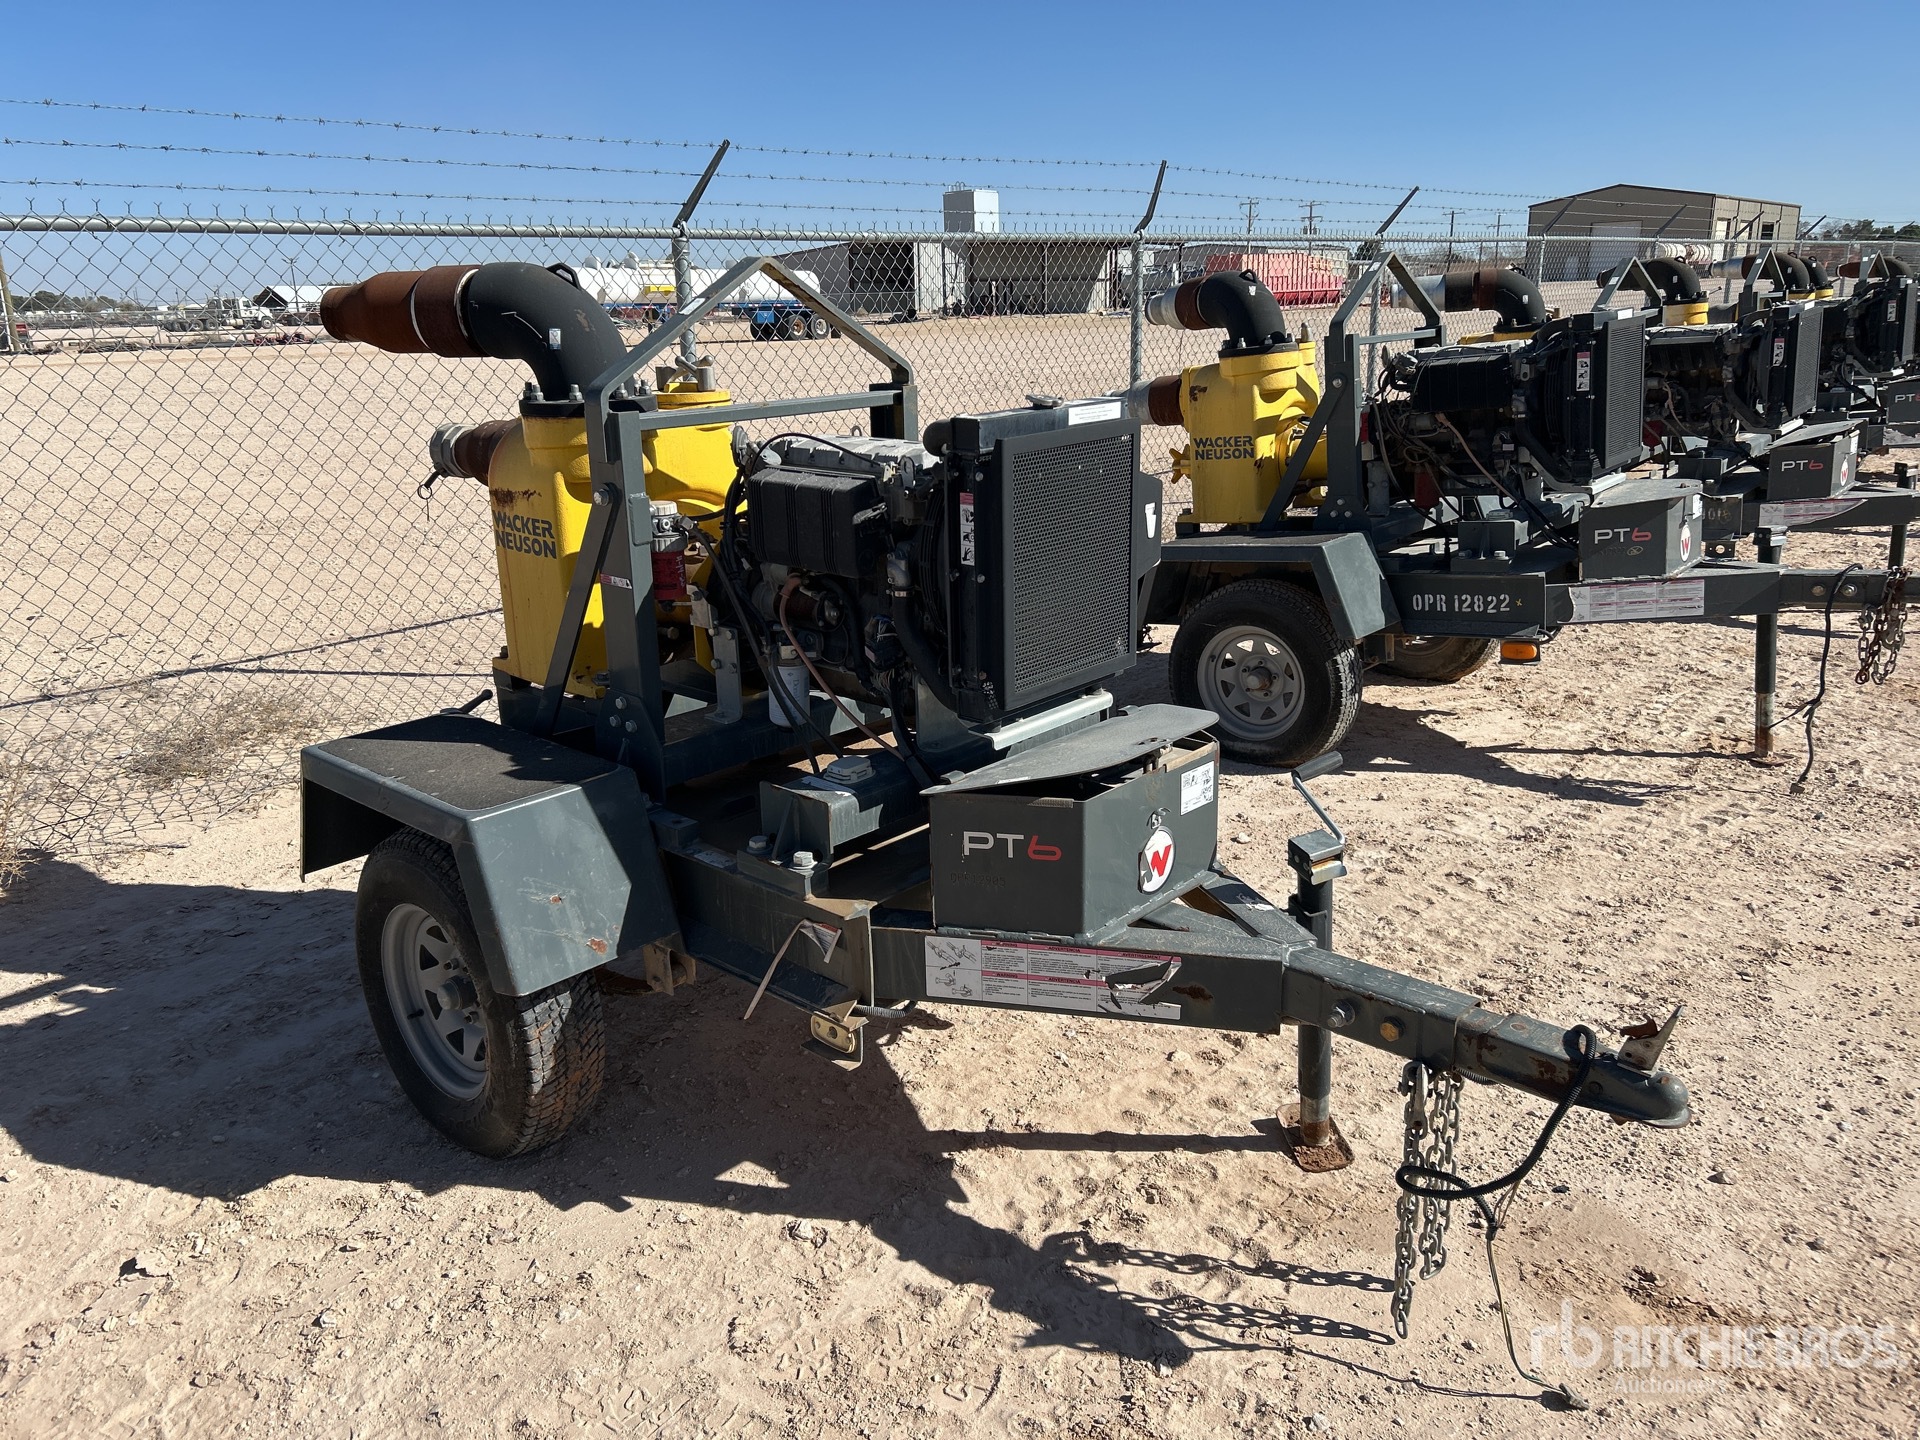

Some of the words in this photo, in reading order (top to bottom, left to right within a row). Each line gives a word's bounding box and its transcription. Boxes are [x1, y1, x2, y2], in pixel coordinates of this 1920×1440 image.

[1193, 435, 1254, 448] WACKER
[1194, 447, 1255, 460] NEUSON
[1781, 459, 1824, 471] PT6
[492, 509, 555, 539] WACKER
[495, 530, 557, 559] NEUSON
[1594, 527, 1652, 544] PT6
[1412, 593, 1447, 612] OPR
[1454, 593, 1510, 613] 12822
[963, 831, 1062, 861] PT6
